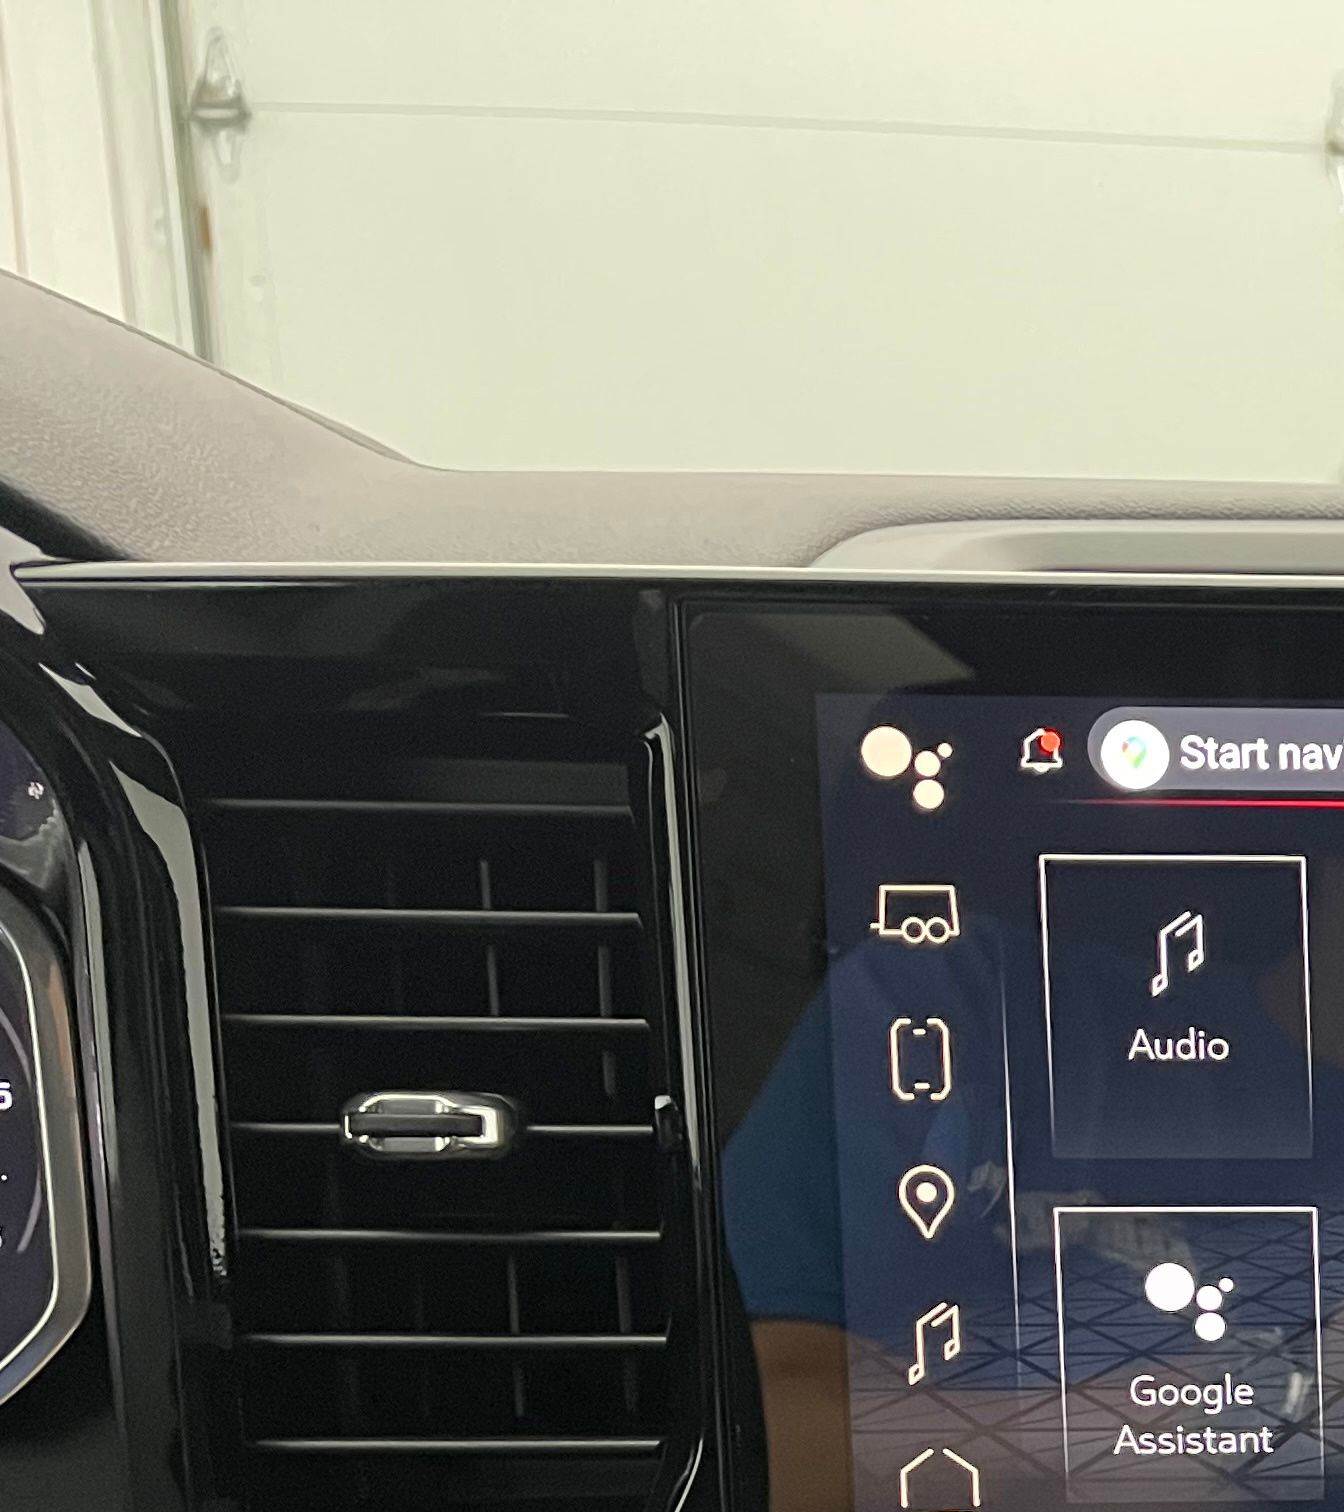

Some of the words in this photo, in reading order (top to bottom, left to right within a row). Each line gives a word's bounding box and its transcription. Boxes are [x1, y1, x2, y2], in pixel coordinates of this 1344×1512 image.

[1180, 734, 1270, 771] Start
[1128, 1026, 1230, 1061] Audio
[1129, 1372, 1255, 1415] Google
[1113, 1424, 1274, 1455] Assistant
